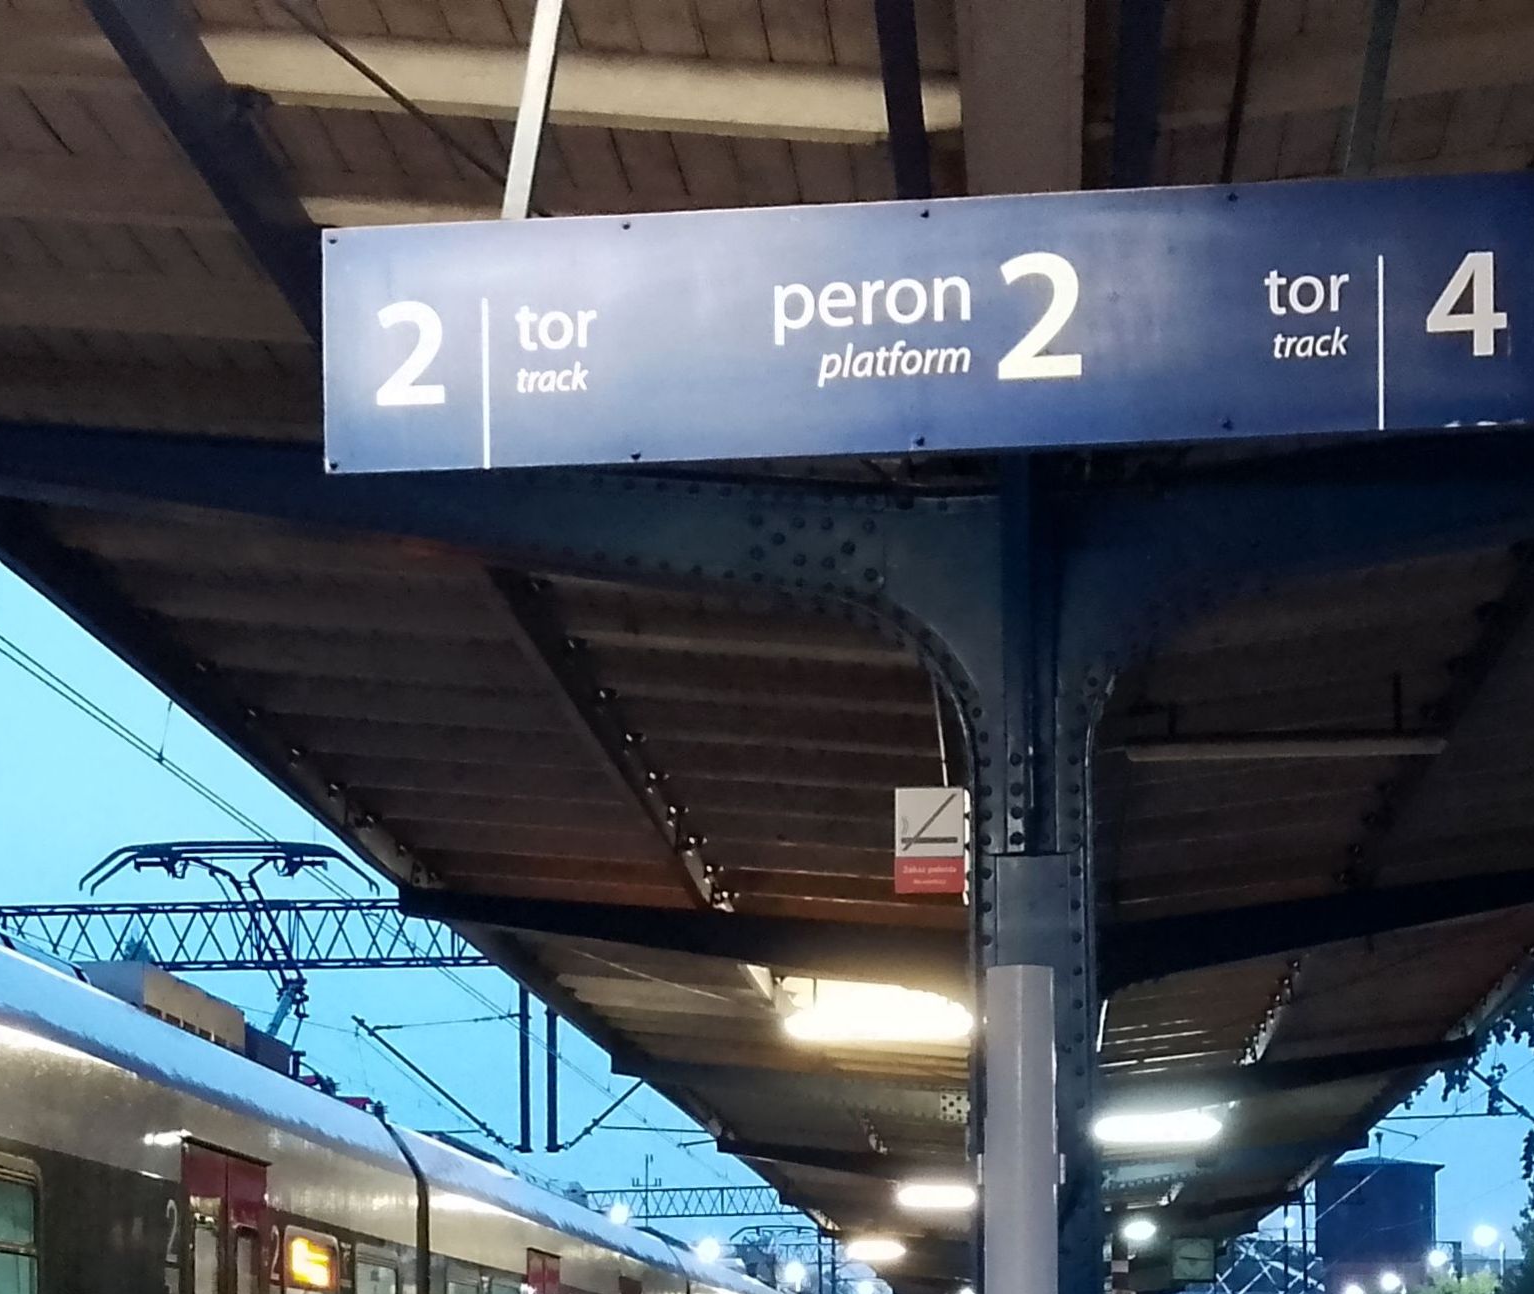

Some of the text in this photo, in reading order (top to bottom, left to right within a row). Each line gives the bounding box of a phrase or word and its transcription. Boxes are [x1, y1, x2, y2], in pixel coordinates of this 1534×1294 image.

[770, 251, 1082, 380] peron 2
[1264, 268, 1350, 316] tor
[1425, 251, 1508, 357] 4
[515, 300, 598, 352] tor
[1272, 326, 1349, 360] track
[375, 300, 446, 406] 2
[516, 360, 589, 394] track
[817, 339, 971, 388] platform
